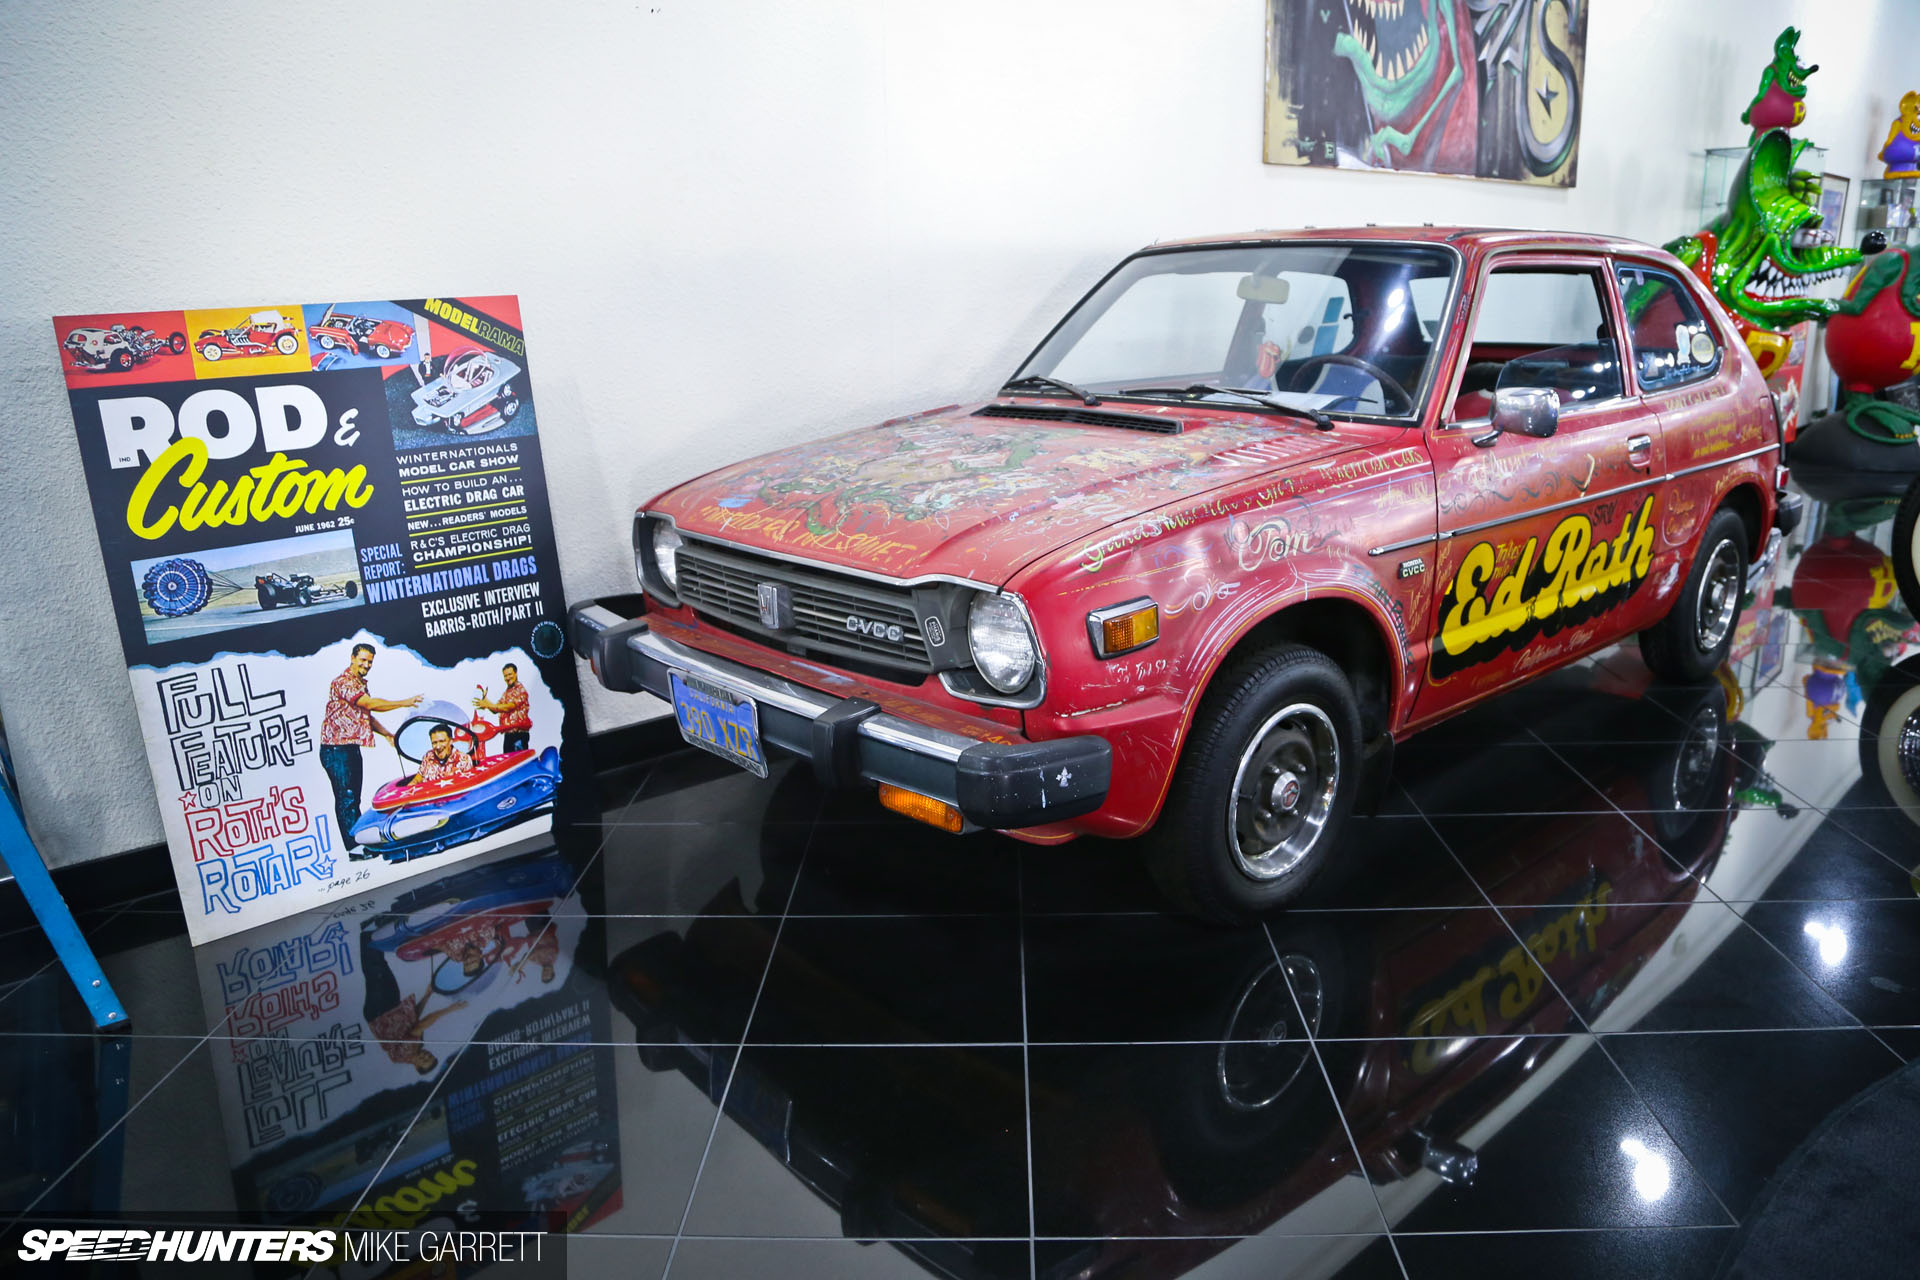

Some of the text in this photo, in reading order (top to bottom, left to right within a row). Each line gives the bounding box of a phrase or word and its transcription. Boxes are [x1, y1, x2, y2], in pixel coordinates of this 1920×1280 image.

[424, 298, 525, 356] MODELRAMA
[98, 385, 360, 469] ROD &
[396, 443, 518, 465] WINTERNATIONALS
[399, 454, 519, 478] MODEL CAR SHOW
[126, 436, 374, 540] Custom
[402, 474, 522, 497] HOW TO BUILD AN...
[404, 485, 525, 513] ELECTRIC DRAG CAR
[295, 524, 315, 534] JUNE
[317, 520, 336, 530] 1962
[491, 506, 527, 519] MODELS
[450, 528, 498, 544] ELECTRIC
[502, 523, 531, 536] DRAG
[361, 543, 403, 563] SPECIAL
[413, 534, 533, 563] CHAMPIONSHIP!
[364, 561, 407, 581] REPORT:
[366, 555, 538, 604] WINTERNATIONAL DRAGS
[1402, 564, 1425, 577] CVCC
[1440, 540, 1539, 656] Ed
[1534, 493, 1656, 620] Roth
[422, 581, 540, 618] EXCLUSIVE INTERVIEW
[425, 600, 544, 639] BARRIS-ROTH/PART II
[846, 615, 903, 642] CVCC
[157, 664, 286, 735] FULL
[170, 714, 313, 791] FEATURE
[198, 774, 242, 808] ON
[185, 786, 309, 862] ROTH'S
[197, 814, 334, 915] ROTAR!
[355, 869, 371, 882] 26
